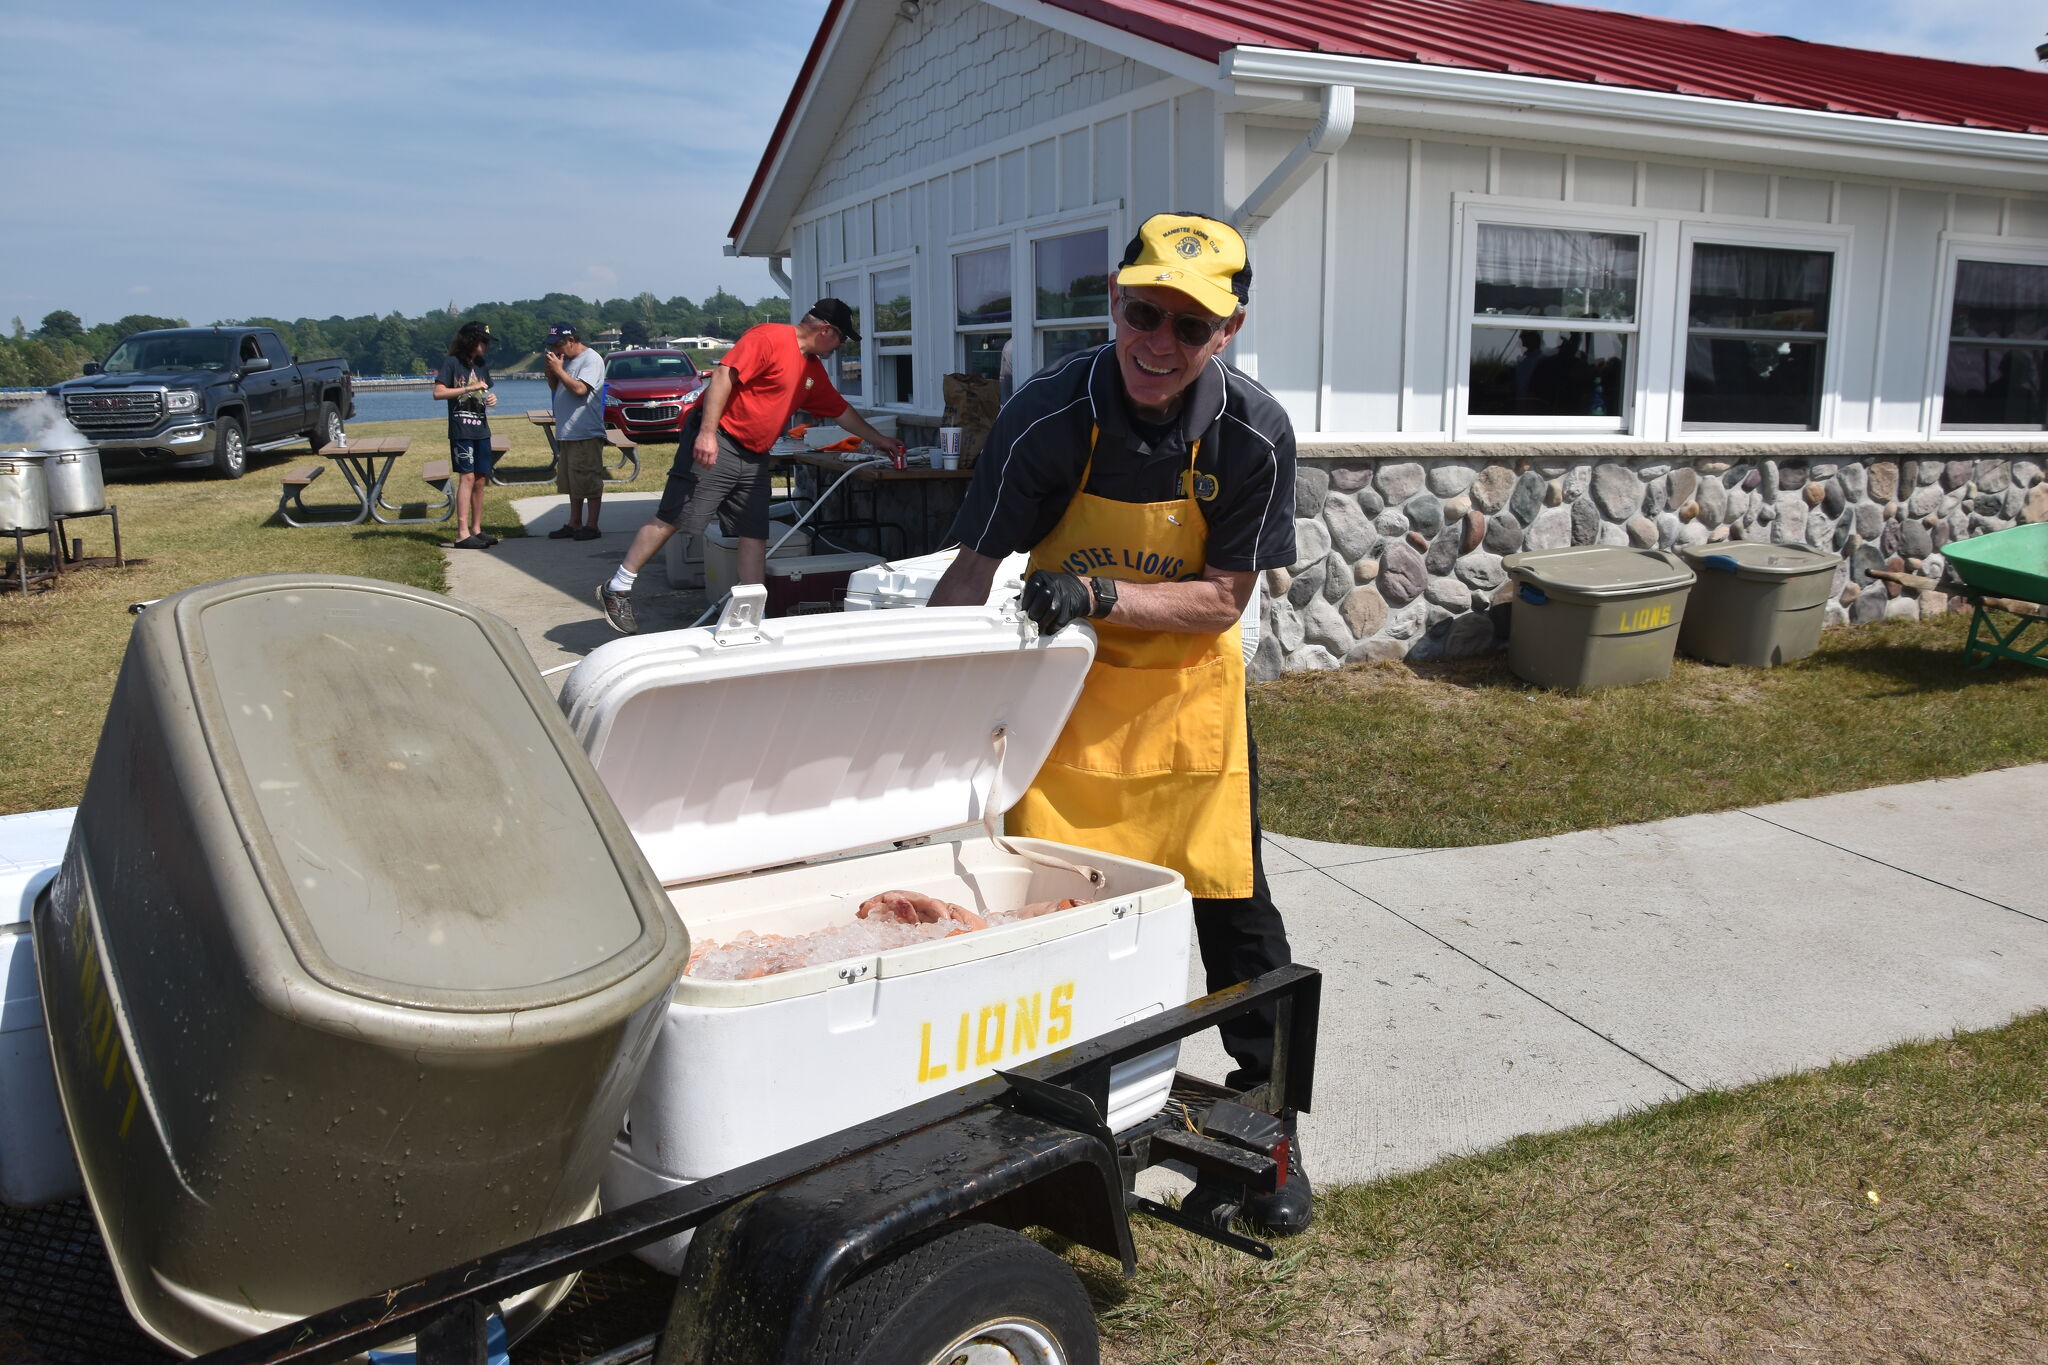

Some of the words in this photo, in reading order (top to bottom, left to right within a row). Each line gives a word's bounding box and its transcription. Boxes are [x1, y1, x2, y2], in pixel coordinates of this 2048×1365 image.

[1163, 227, 1190, 238] MANISTEE
[1193, 229, 1208, 240] LIONS
[1209, 240, 1220, 253] CLUB
[1123, 549, 1184, 578] LIONS
[1619, 604, 1672, 632] LIONS
[917, 981, 1076, 1084] LIONS
